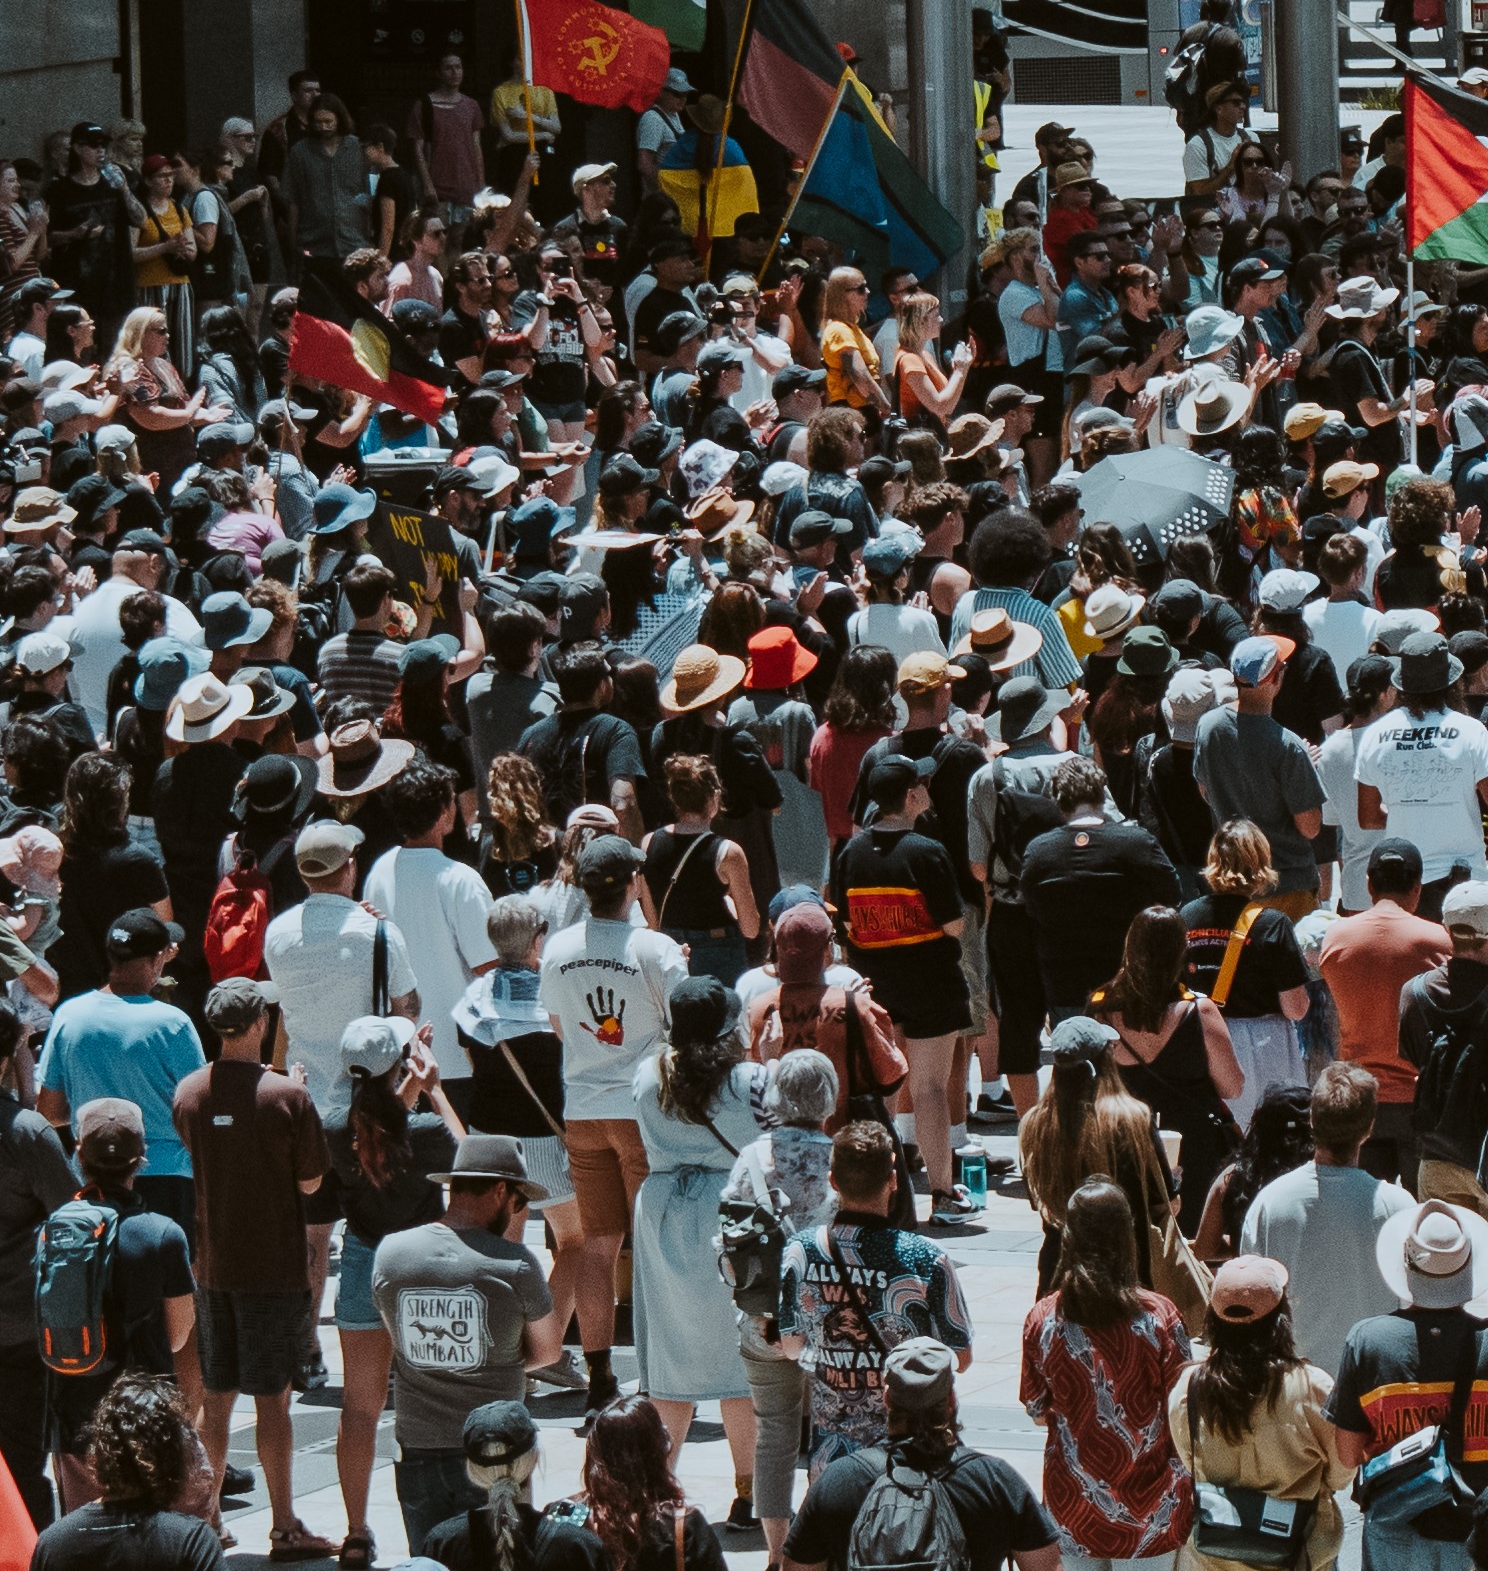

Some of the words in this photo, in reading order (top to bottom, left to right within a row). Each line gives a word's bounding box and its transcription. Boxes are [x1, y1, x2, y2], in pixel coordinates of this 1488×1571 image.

[389, 511, 425, 547] NOT
[1377, 726, 1460, 744] WEEKEND
[1395, 741, 1415, 751] Run
[559, 958, 640, 977] peacepiper
[407, 1298, 474, 1319] STRENGTH
[409, 1343, 475, 1364] NUMBATS
